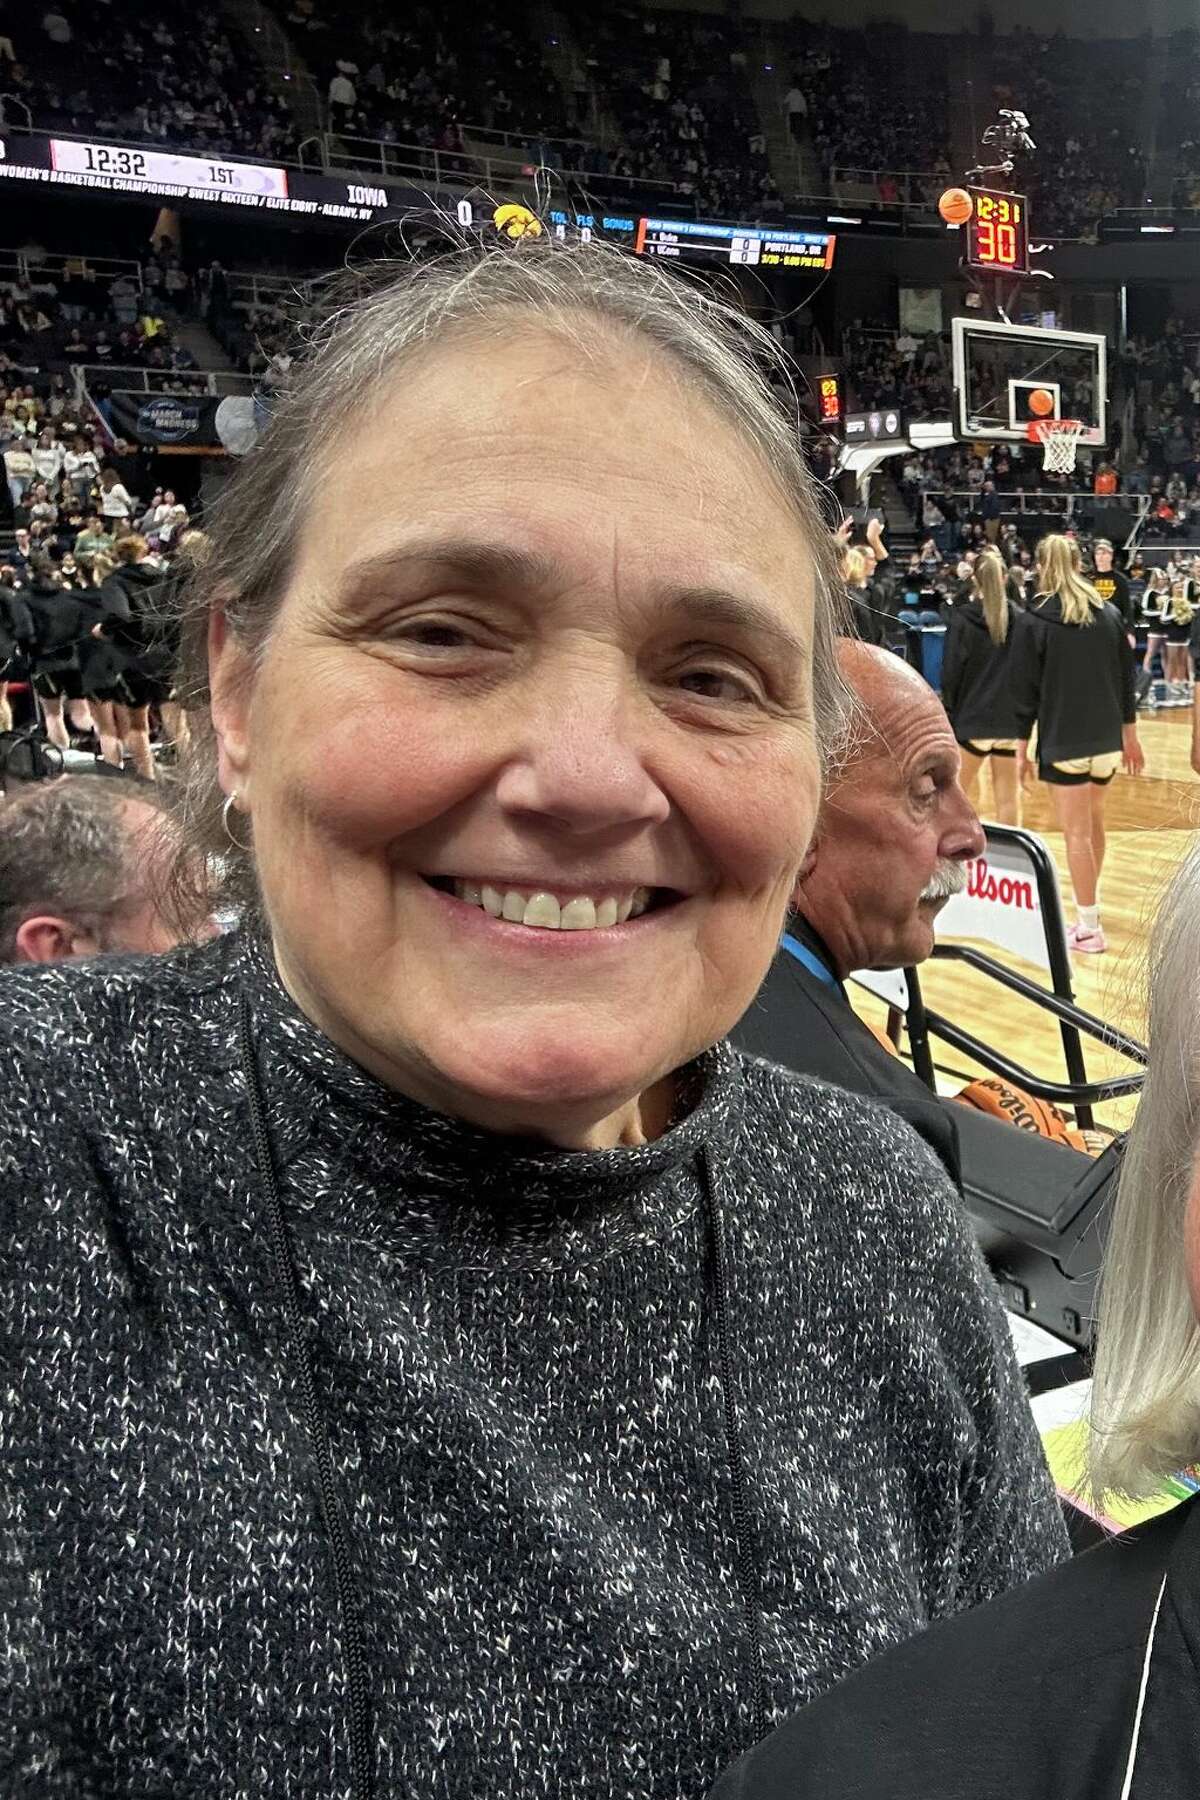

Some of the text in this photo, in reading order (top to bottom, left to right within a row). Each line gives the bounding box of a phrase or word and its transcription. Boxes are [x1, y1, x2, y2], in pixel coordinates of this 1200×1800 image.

[85, 148, 146, 177] 12:32
[209, 166, 235, 184] 1ST
[51, 170, 112, 190] BASKETBALL
[112, 179, 188, 197] CHAMPIONSHIP
[188, 188, 219, 202] SWEET
[347, 184, 388, 208] IOWA
[457, 199, 473, 227] 0
[977, 197, 1020, 224] 12:31
[977, 221, 1016, 263] 30
[966, 857, 1034, 910] ilson
